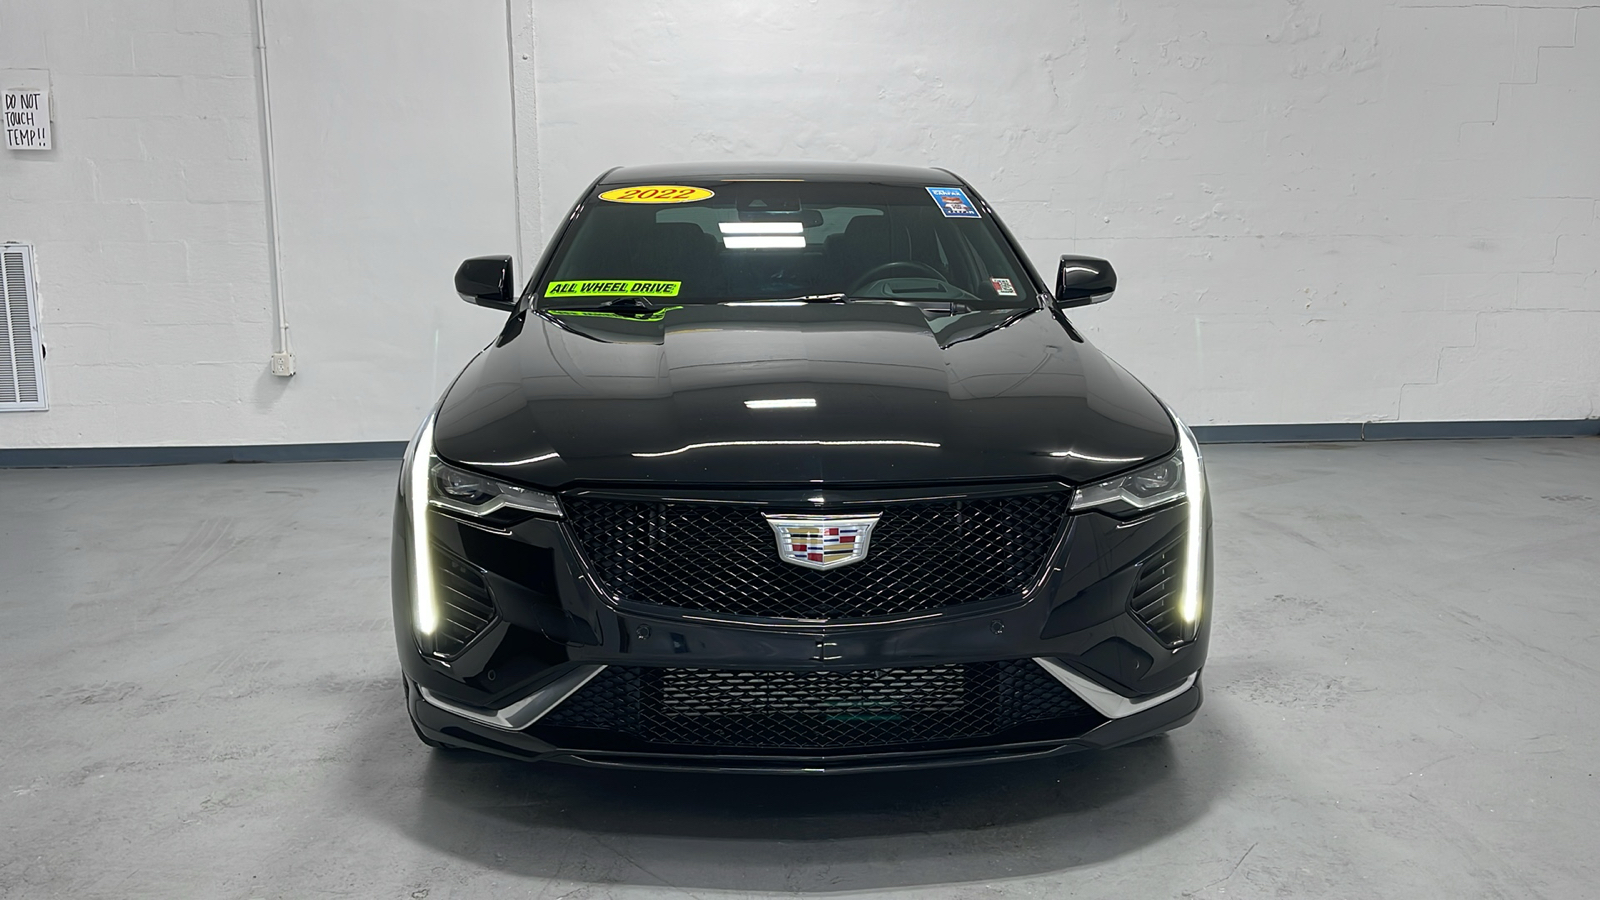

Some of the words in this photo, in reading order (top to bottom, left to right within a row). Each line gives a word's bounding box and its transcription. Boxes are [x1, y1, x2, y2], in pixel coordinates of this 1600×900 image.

[5, 94, 16, 110] DO
[21, 94, 40, 110] NOT
[5, 112, 35, 127] TOUCH
[7, 128, 46, 146] TEMP!!
[617, 189, 695, 199] 2022
[550, 284, 577, 293] ALL
[580, 283, 628, 293] WHEEL
[630, 283, 675, 293] DRIVE
